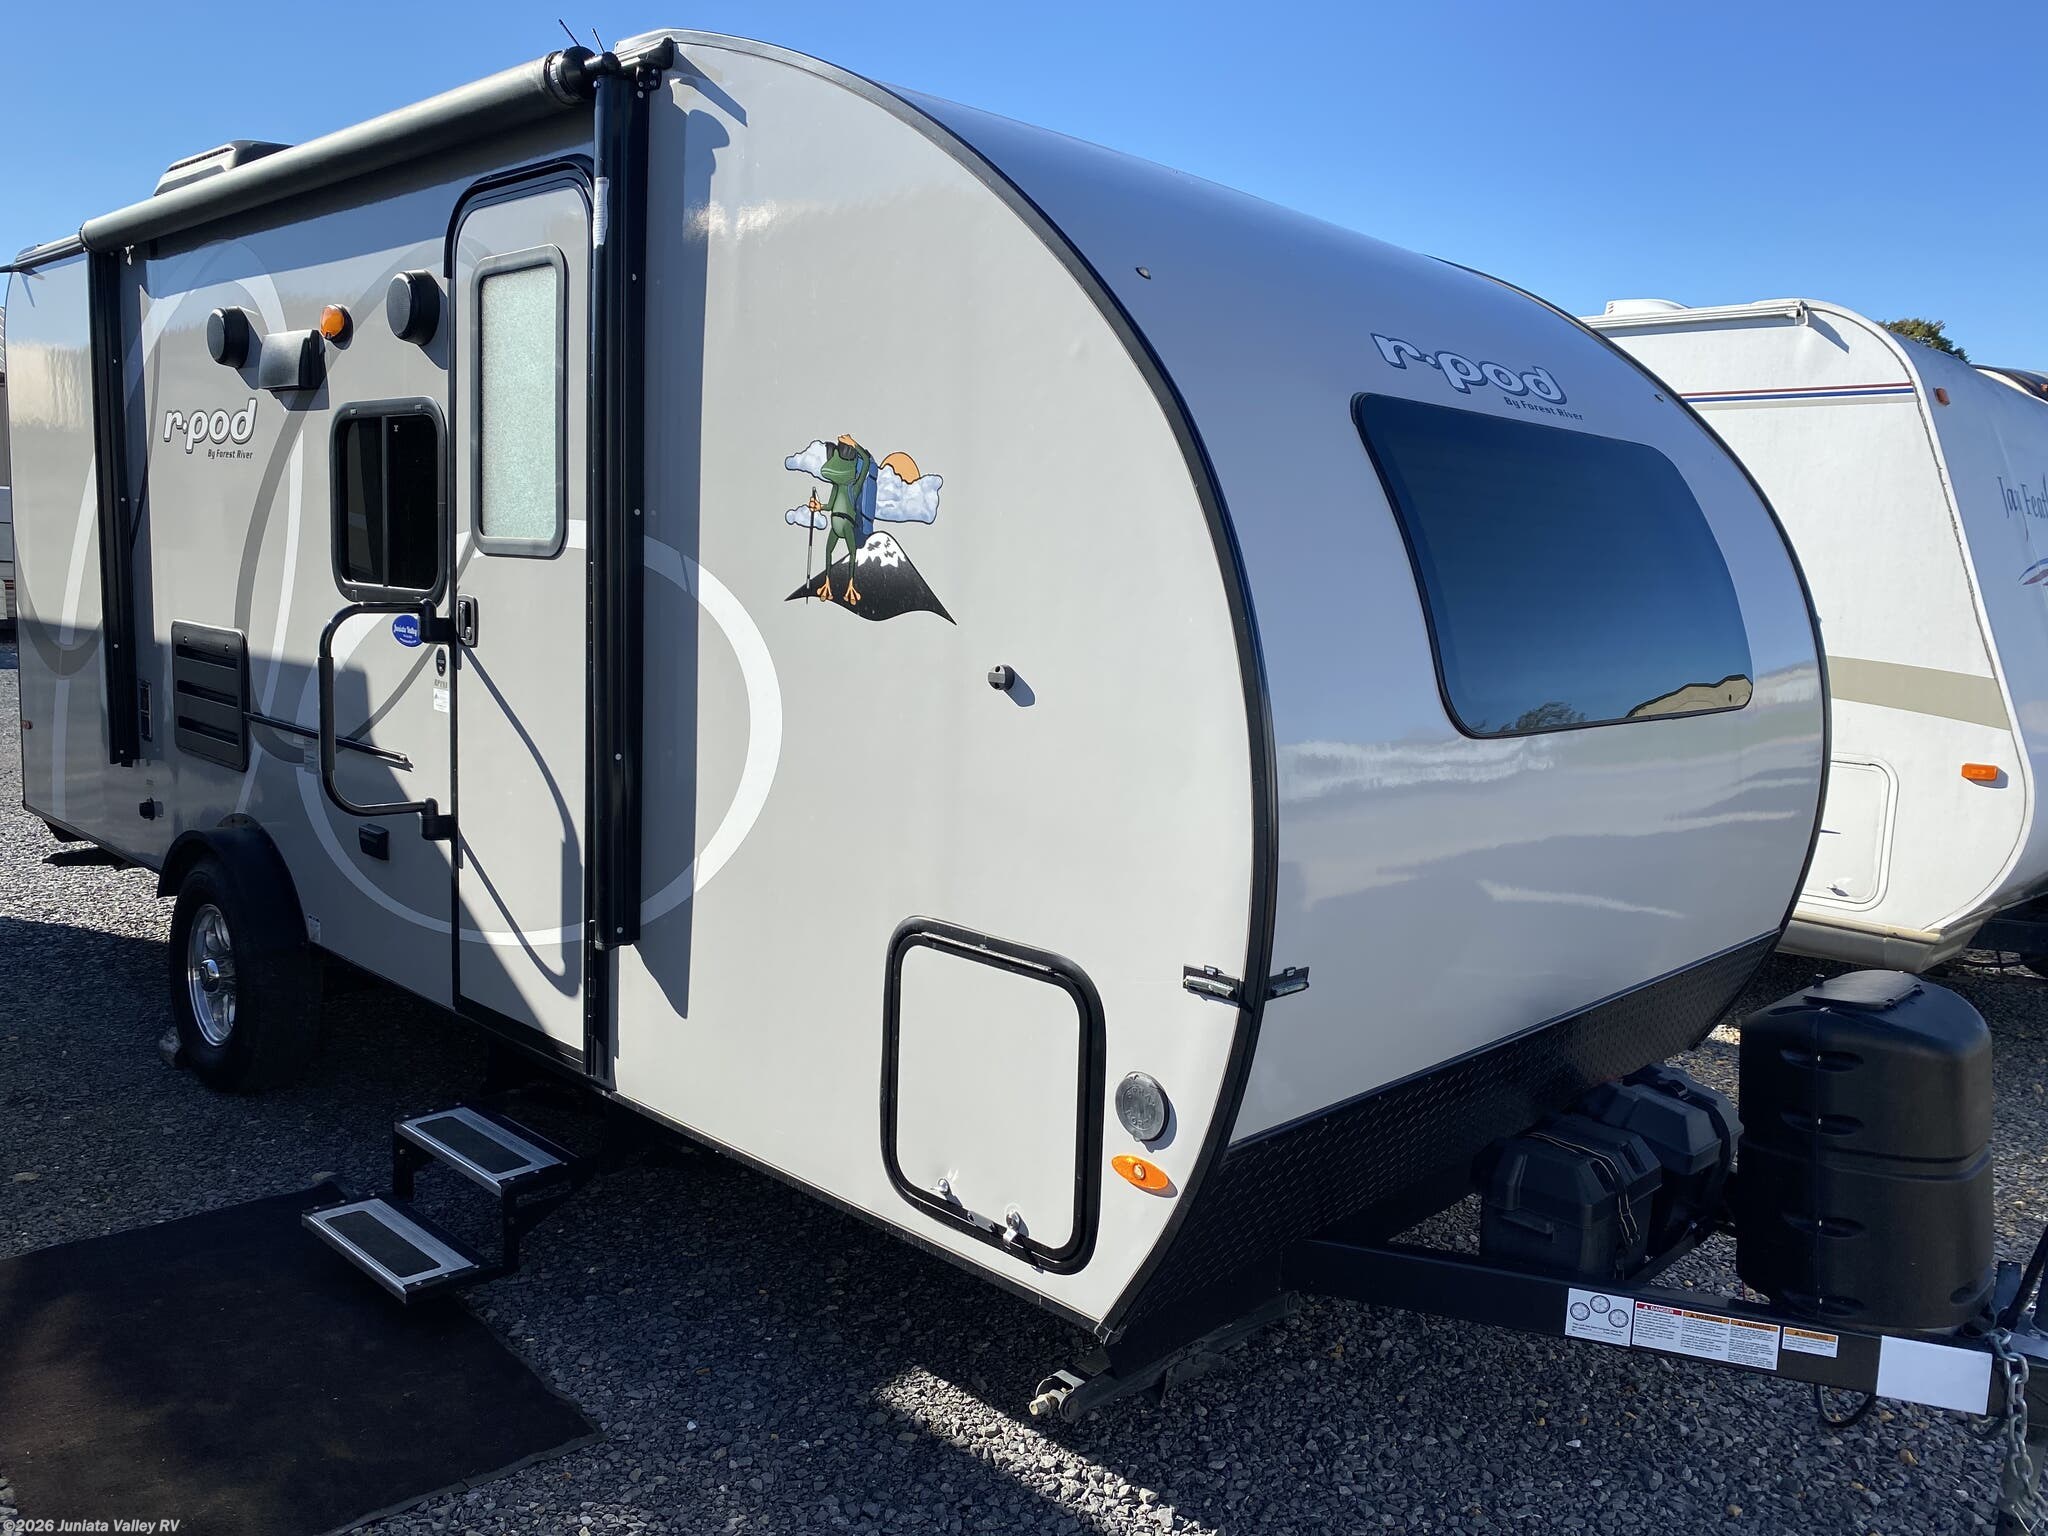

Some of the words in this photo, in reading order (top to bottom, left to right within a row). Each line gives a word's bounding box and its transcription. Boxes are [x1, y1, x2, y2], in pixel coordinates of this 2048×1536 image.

[1503, 396, 1520, 409] By
[1520, 400, 1554, 415] Forest
[1554, 407, 1584, 421] River
[207, 448, 215, 459] By
[216, 449, 235, 459] Forest
[236, 450, 253, 459] River
